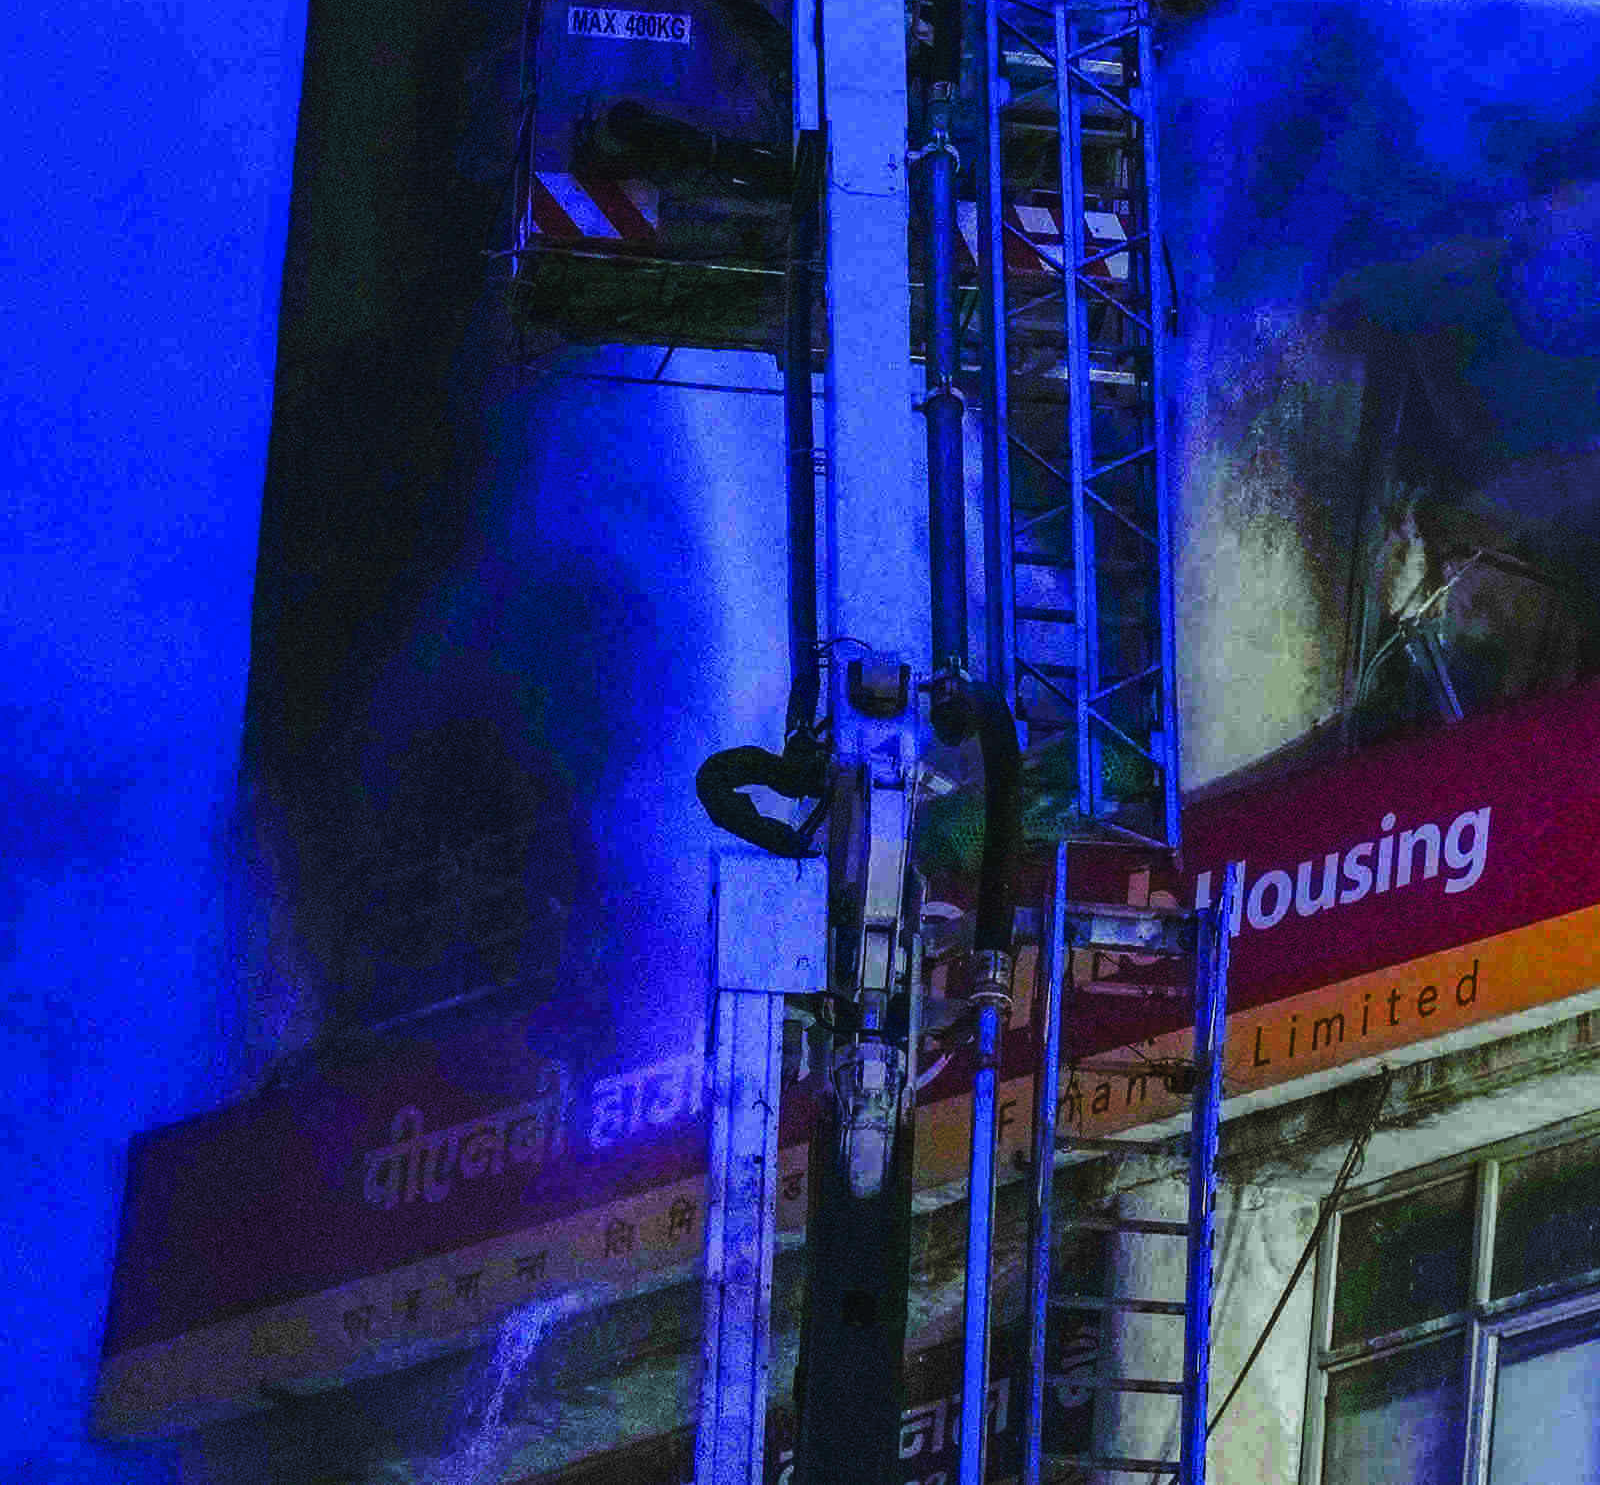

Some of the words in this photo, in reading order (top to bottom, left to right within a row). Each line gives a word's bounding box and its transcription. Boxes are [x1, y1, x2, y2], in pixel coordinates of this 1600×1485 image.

[572, 10, 617, 34] MAX
[625, 14, 686, 40] 400KG
[1252, 958, 1481, 1068] Limited
